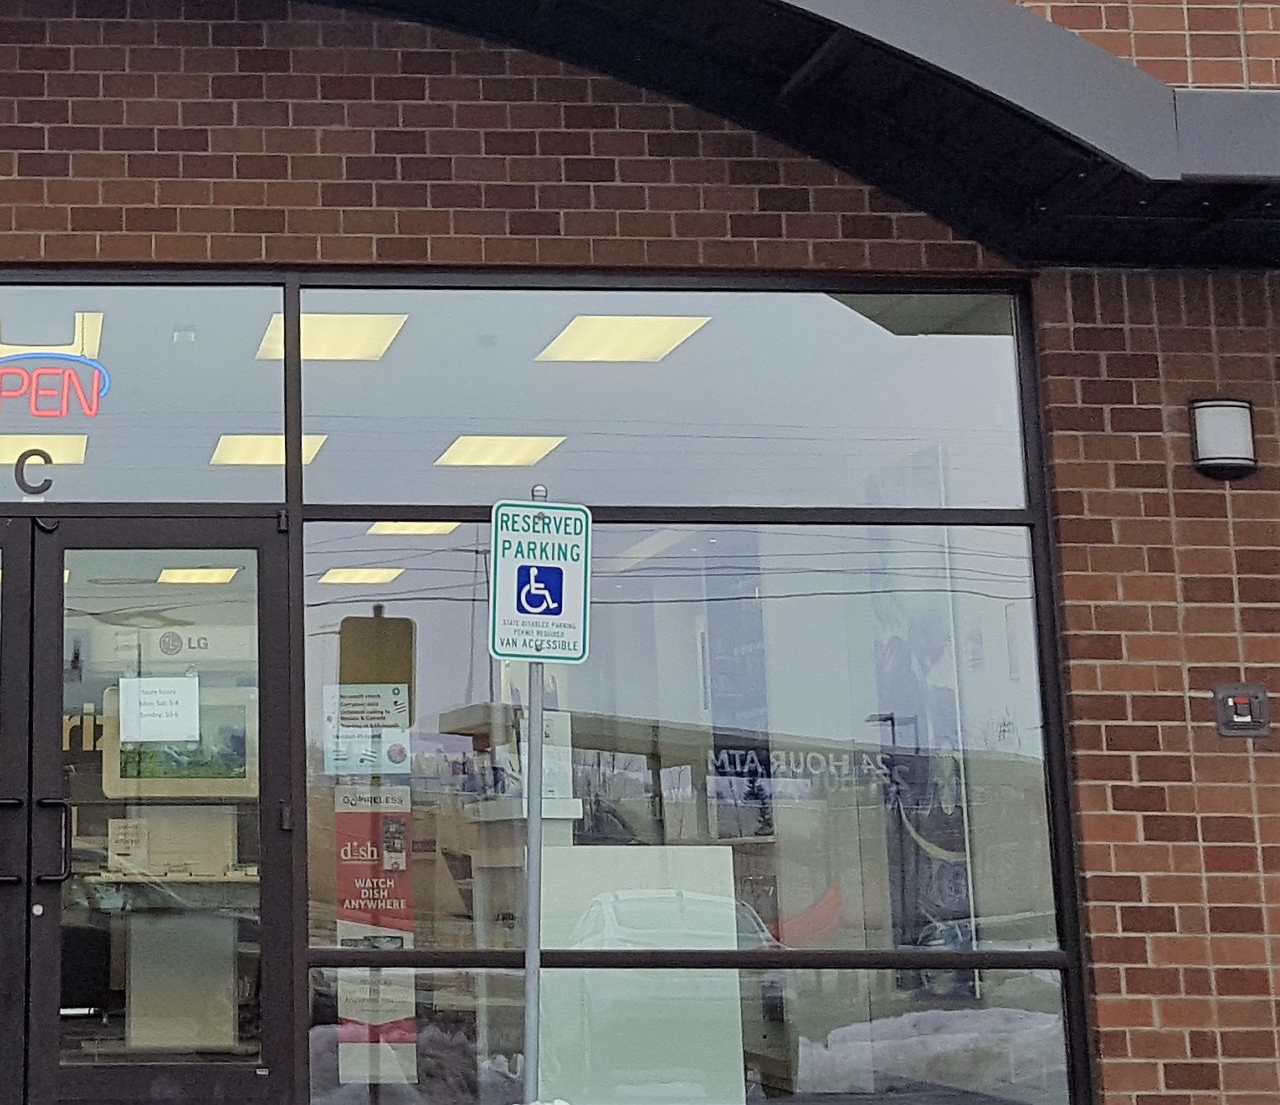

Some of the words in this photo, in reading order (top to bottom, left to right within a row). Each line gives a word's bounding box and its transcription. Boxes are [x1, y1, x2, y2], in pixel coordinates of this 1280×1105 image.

[14, 448, 54, 495] C
[500, 513, 584, 536] RESERVED
[501, 540, 581, 562] PARKING
[551, 622, 577, 630] PARKING
[187, 636, 209, 650] LG
[499, 637, 518, 648] VAN
[521, 638, 579, 652] ACCESSIBLE
[340, 842, 378, 861] dish
[354, 878, 395, 888] WATCH
[361, 889, 388, 899] DISH
[343, 899, 407, 910] ANYWHERE
